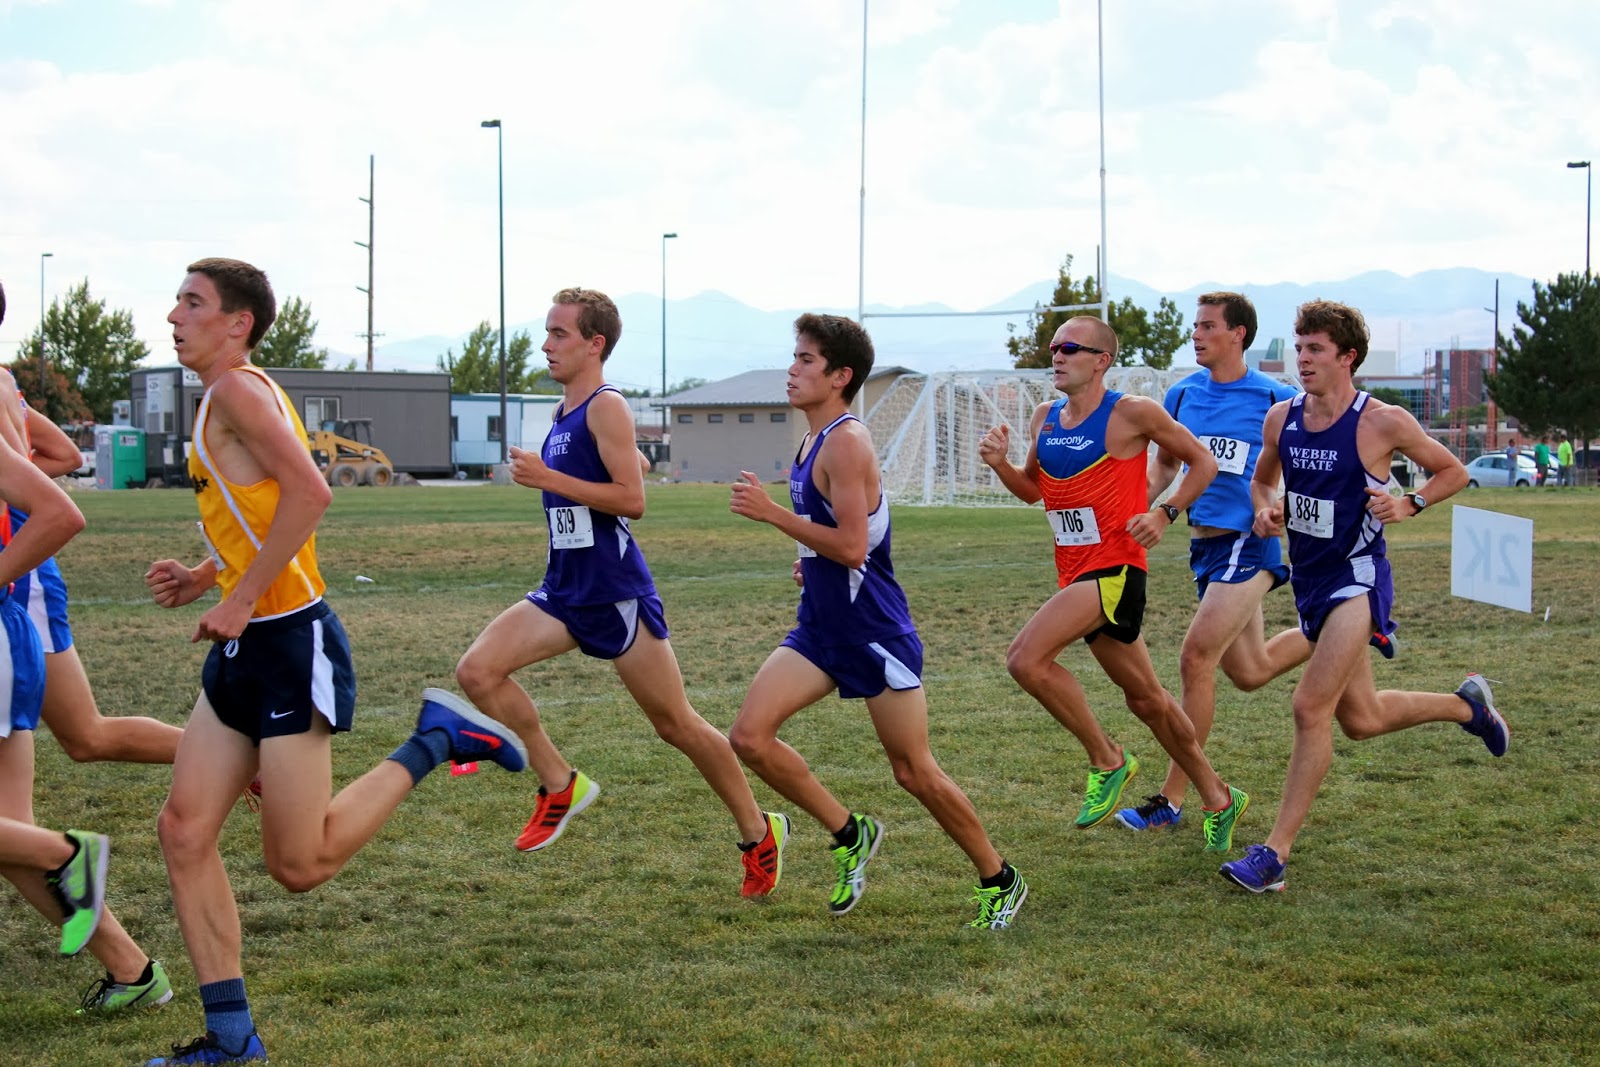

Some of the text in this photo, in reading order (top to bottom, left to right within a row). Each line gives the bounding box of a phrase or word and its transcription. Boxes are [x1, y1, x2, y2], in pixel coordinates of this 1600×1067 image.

[1046, 435, 1084, 446] saucony
[1210, 437, 1237, 460] 893
[1289, 446, 1338, 461] WEBER
[1292, 458, 1333, 471] STATE
[1296, 495, 1320, 523] 884
[556, 508, 575, 534] 879
[1056, 510, 1083, 533] 706
